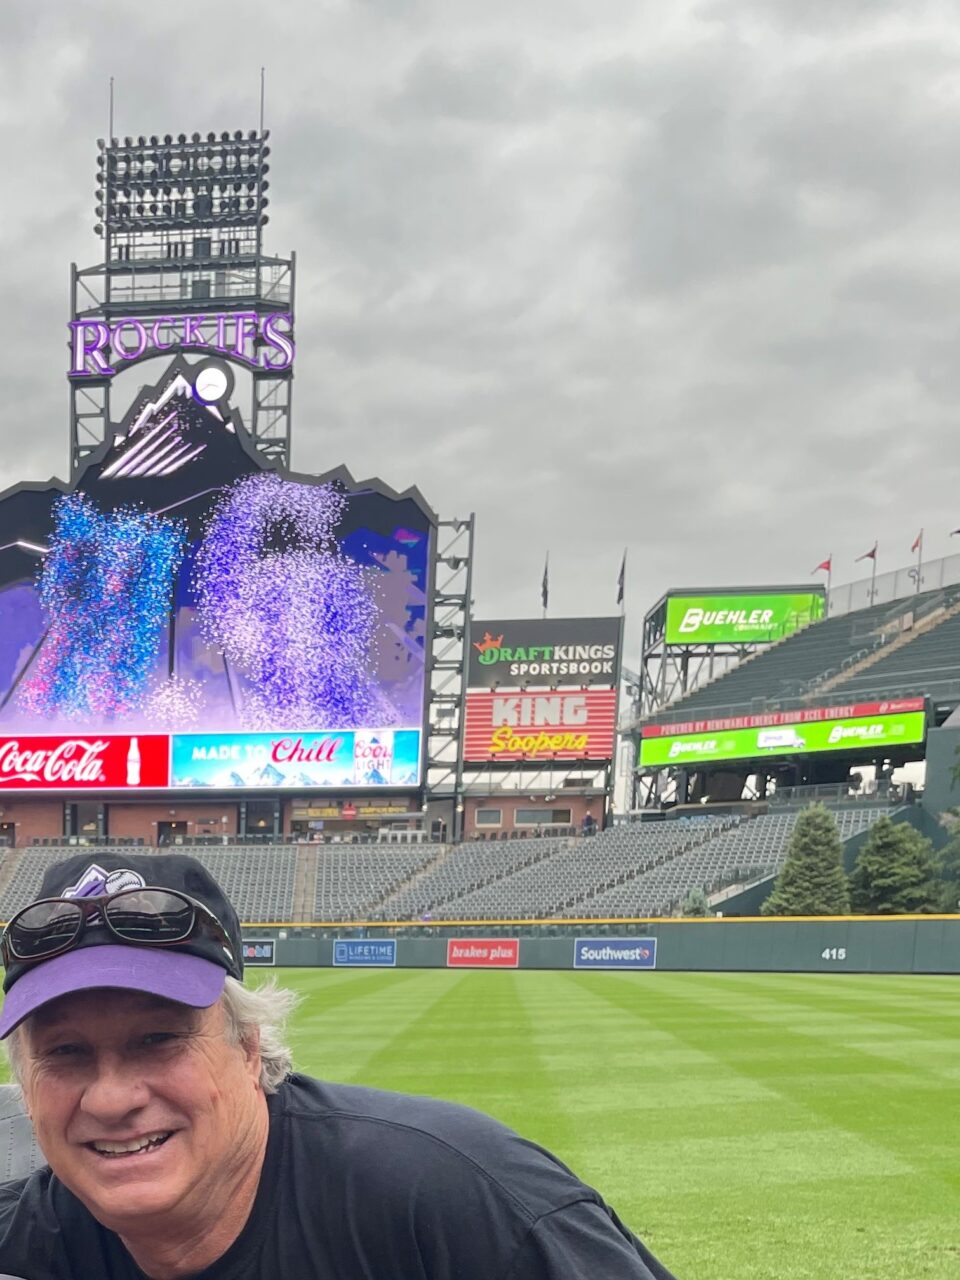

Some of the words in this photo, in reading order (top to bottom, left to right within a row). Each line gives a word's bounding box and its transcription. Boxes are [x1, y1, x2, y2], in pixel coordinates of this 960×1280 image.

[68, 312, 295, 376] ROCKIES
[678, 608, 774, 633] BUEHLER
[478, 644, 615, 665] DRAFTKINGS
[510, 662, 613, 676] SPORTSBOOK
[491, 695, 589, 727] KING
[488, 726, 589, 758] Soopers
[827, 723, 885, 744] BUEHLER
[192, 745, 240, 761] MADE
[247, 743, 268, 760] TO
[271, 737, 344, 764] Chill
[356, 760, 391, 770] LIGHT
[348, 945, 393, 956] LIFETIME
[451, 946, 488, 958] brakes
[489, 945, 514, 960] plus
[580, 946, 642, 961] Southwest
[821, 947, 846, 960] 415
